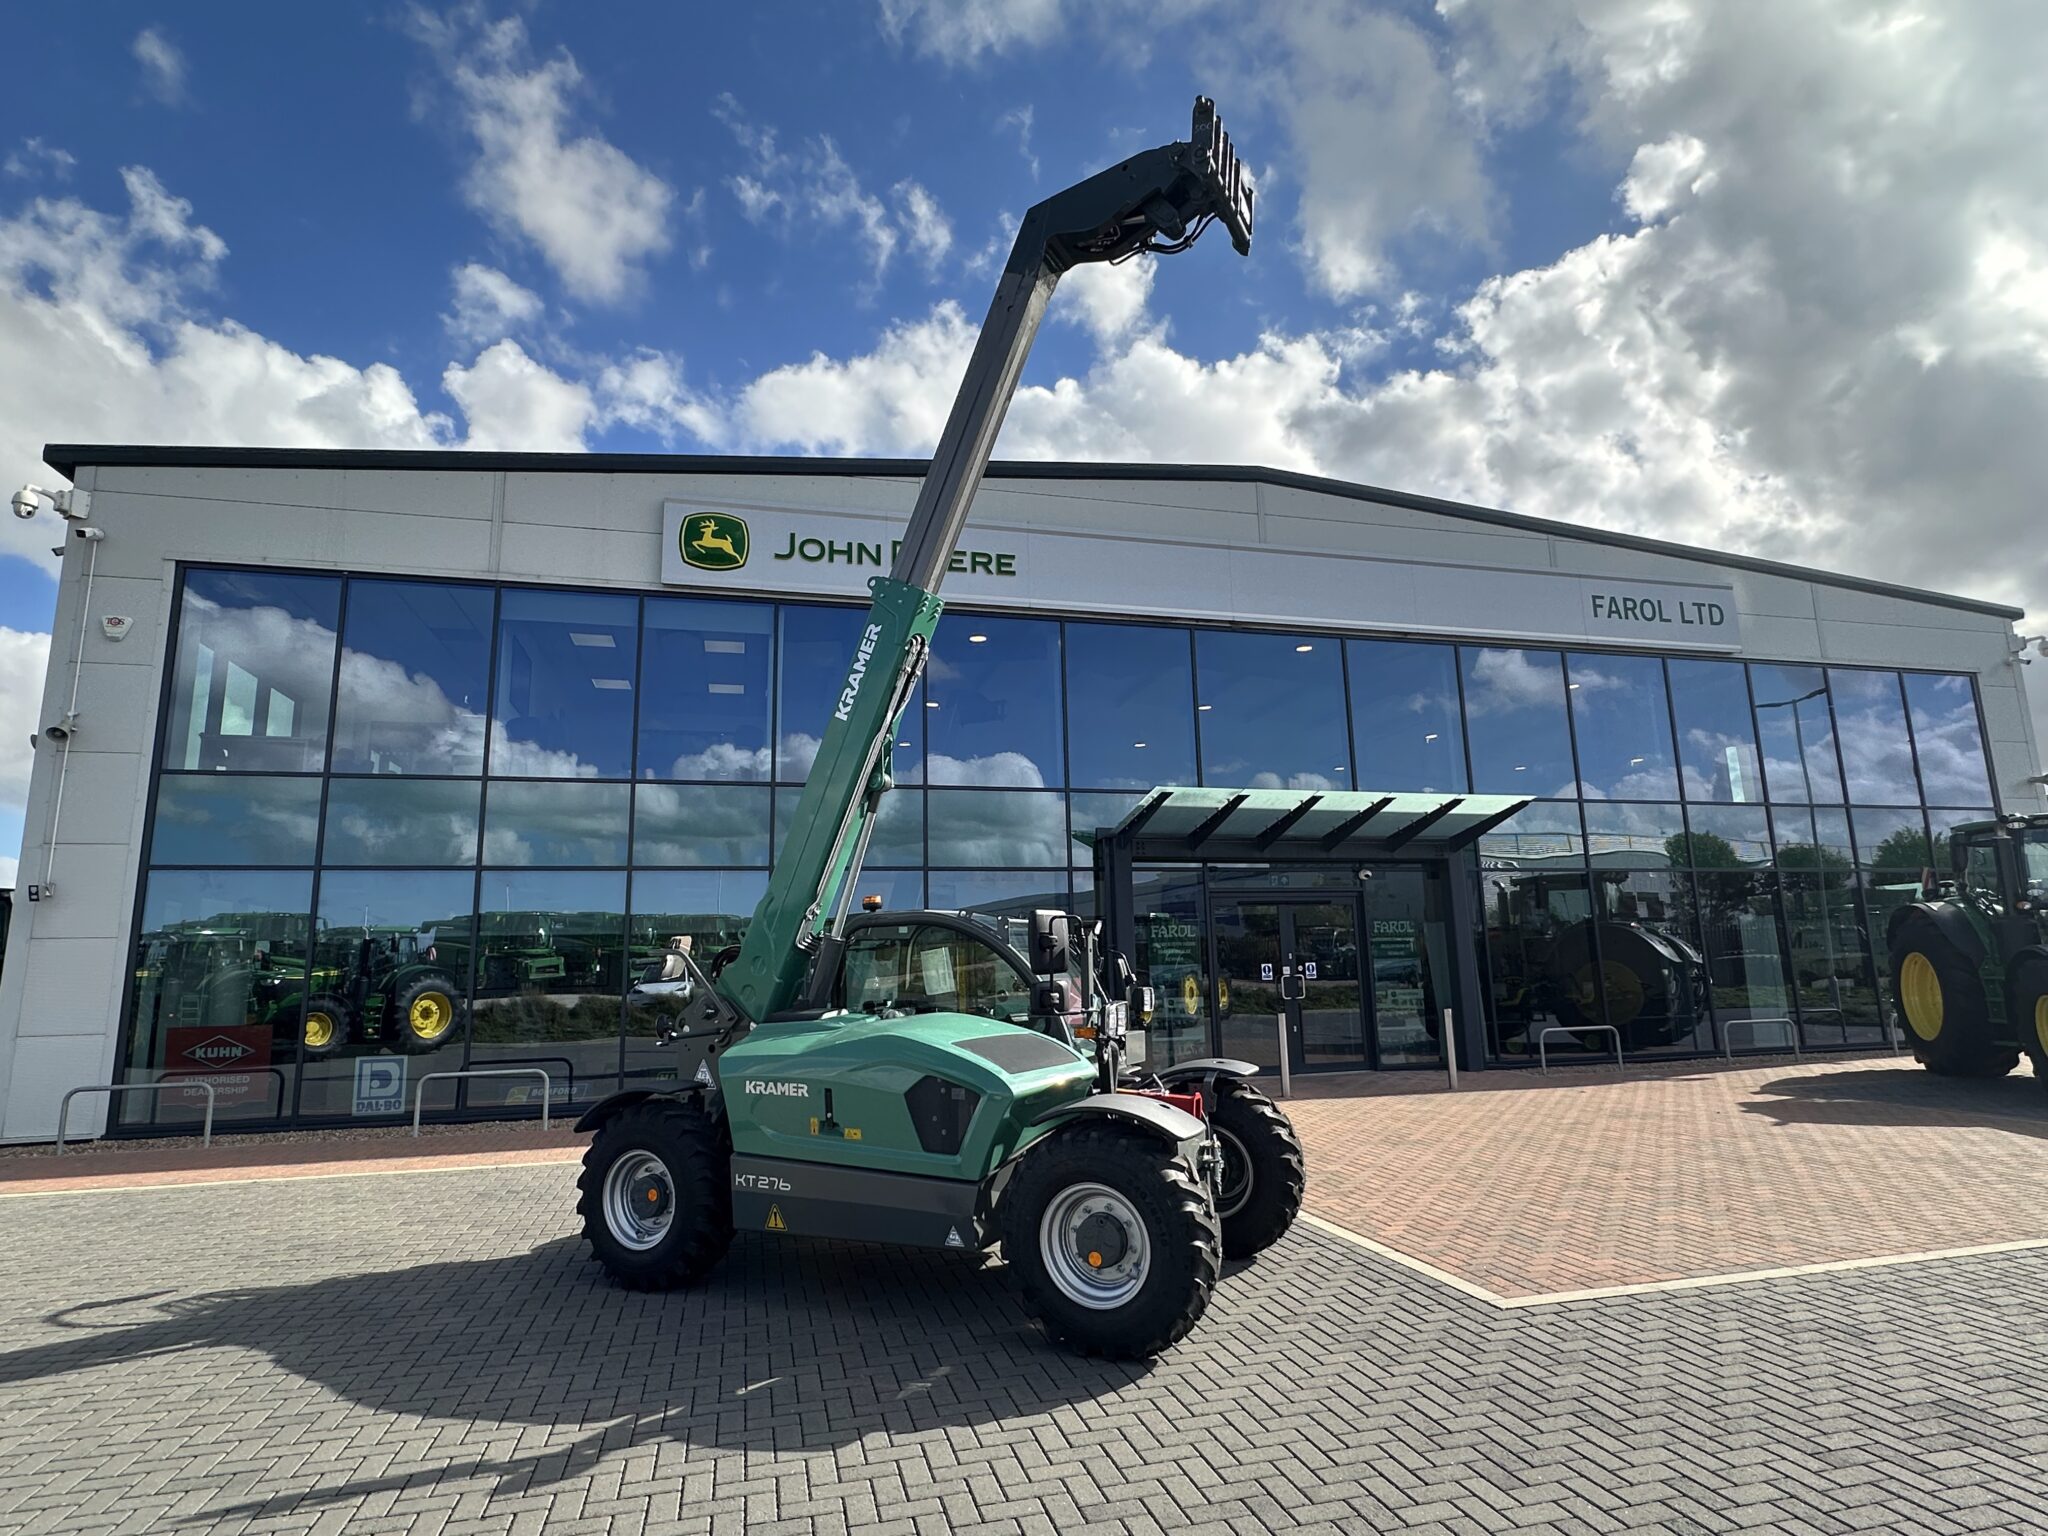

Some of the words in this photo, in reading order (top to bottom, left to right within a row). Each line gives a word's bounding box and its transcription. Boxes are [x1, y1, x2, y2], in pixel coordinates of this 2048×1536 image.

[774, 532, 882, 566] JOHN
[891, 540, 1016, 576] ERE
[1591, 594, 1672, 623] FAROL
[1679, 601, 1725, 626] LTD
[834, 623, 882, 721] KRAMER
[1150, 925, 1196, 937] FAROL
[1373, 920, 1415, 933] FAROL
[195, 1047, 243, 1058] KUHN
[183, 1075, 250, 1085] AUTHORISED
[531, 1087, 577, 1096] BOFORD
[745, 1080, 809, 1097] KRAMER
[735, 1173, 792, 1191] KT276
